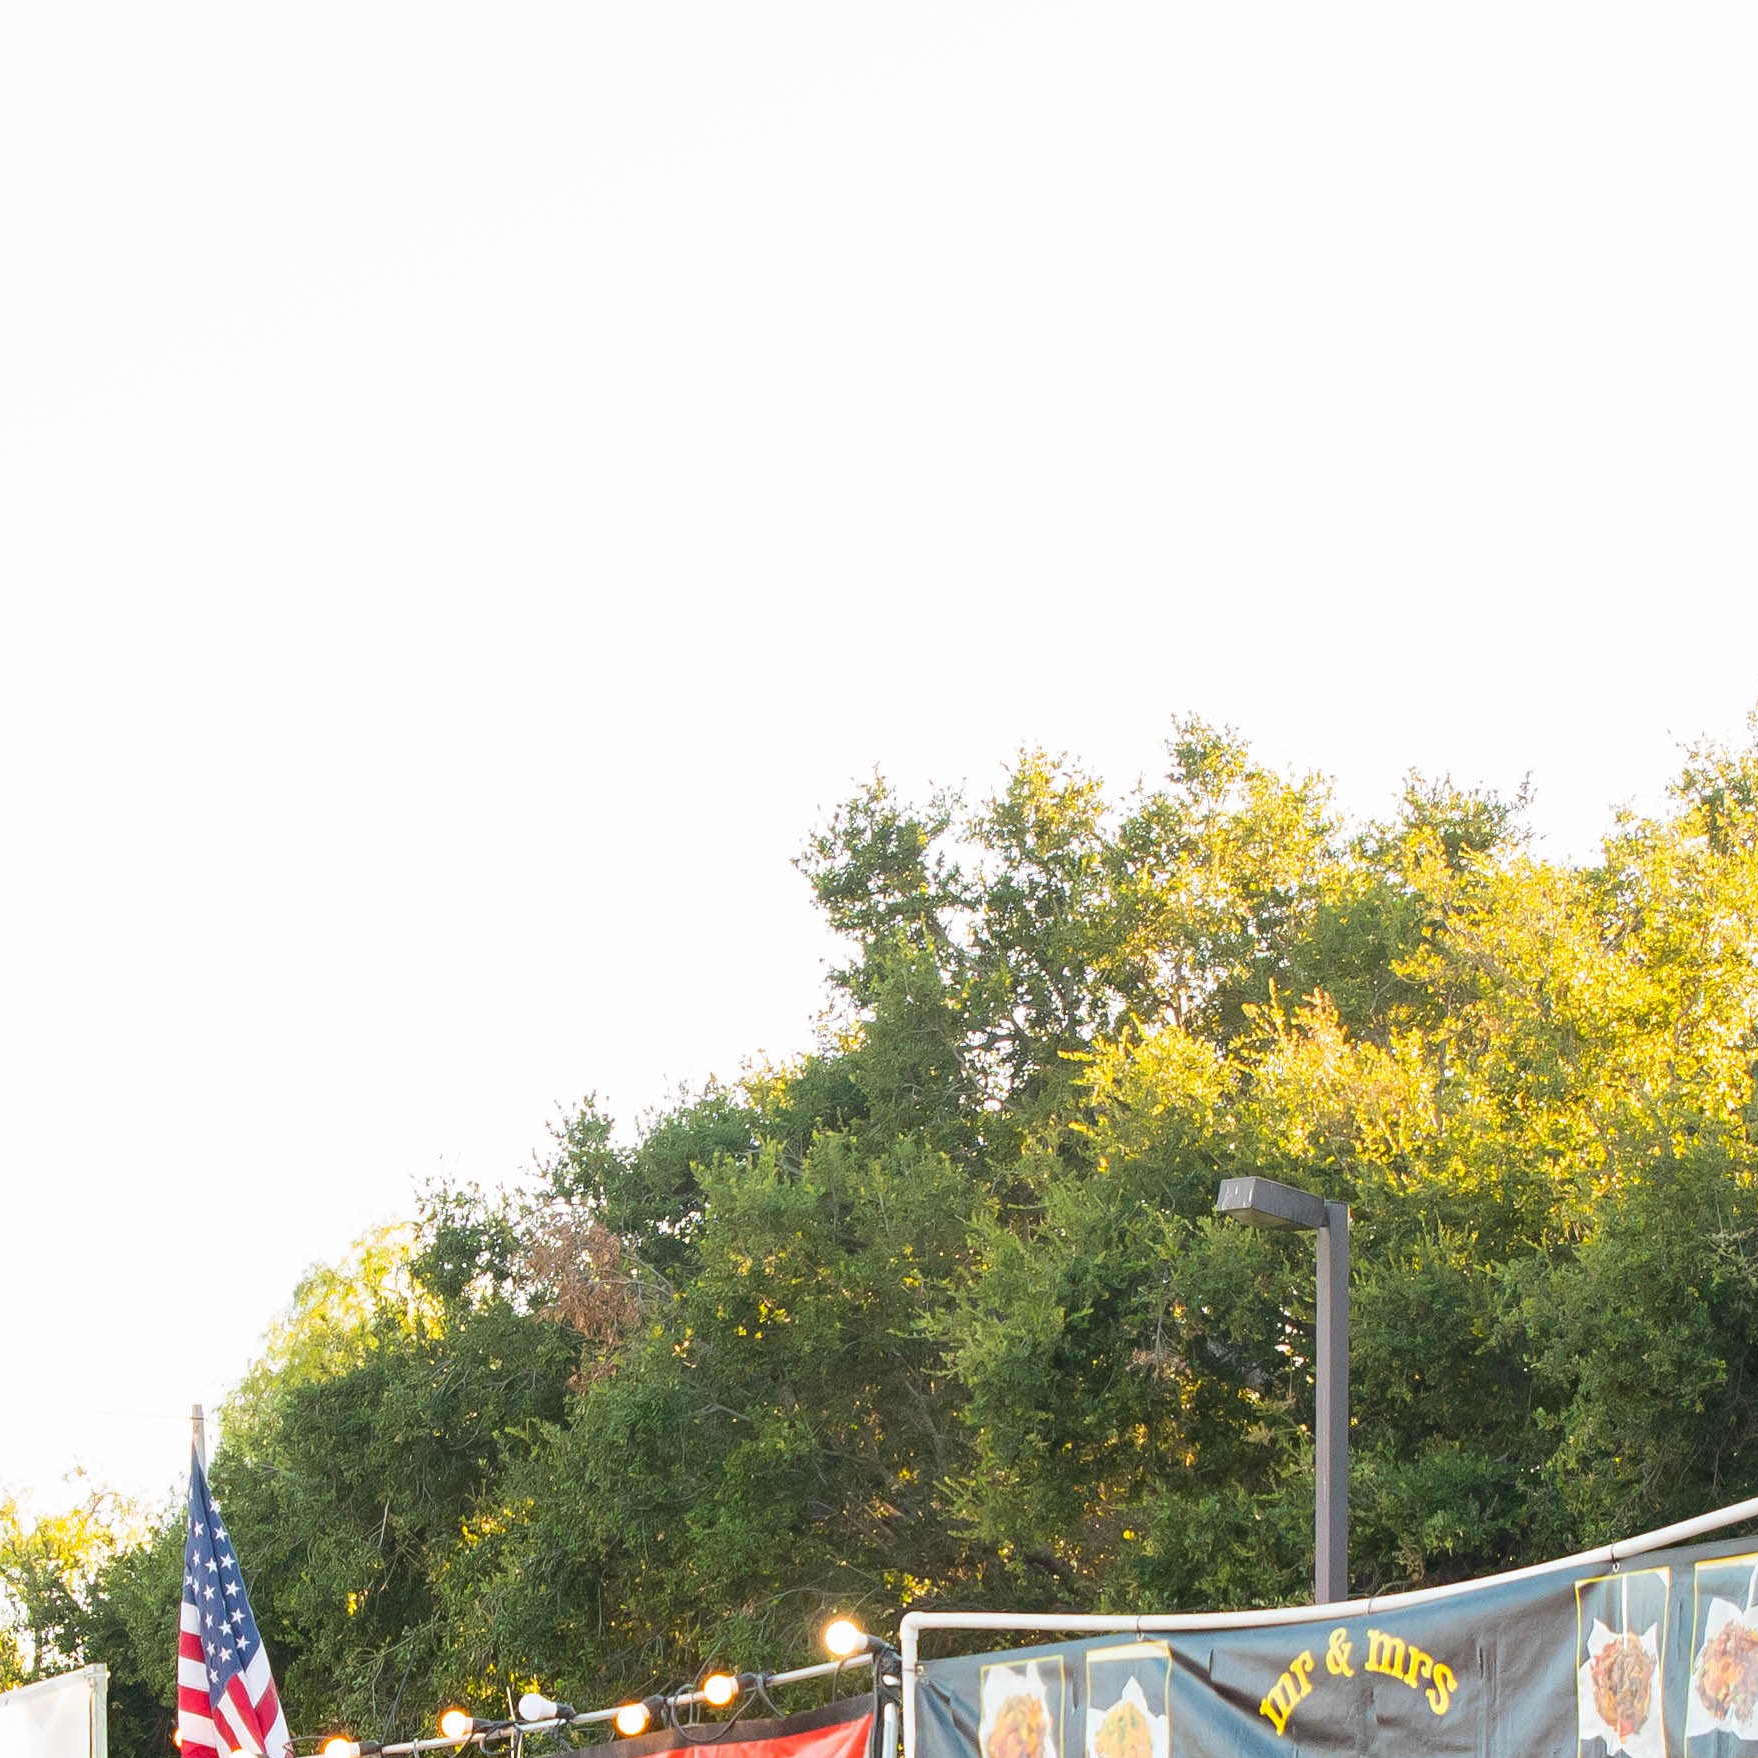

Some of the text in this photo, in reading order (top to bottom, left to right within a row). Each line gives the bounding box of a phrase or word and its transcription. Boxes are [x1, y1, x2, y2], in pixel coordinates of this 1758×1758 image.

[1259, 1627, 1458, 1736] mr & mrs
